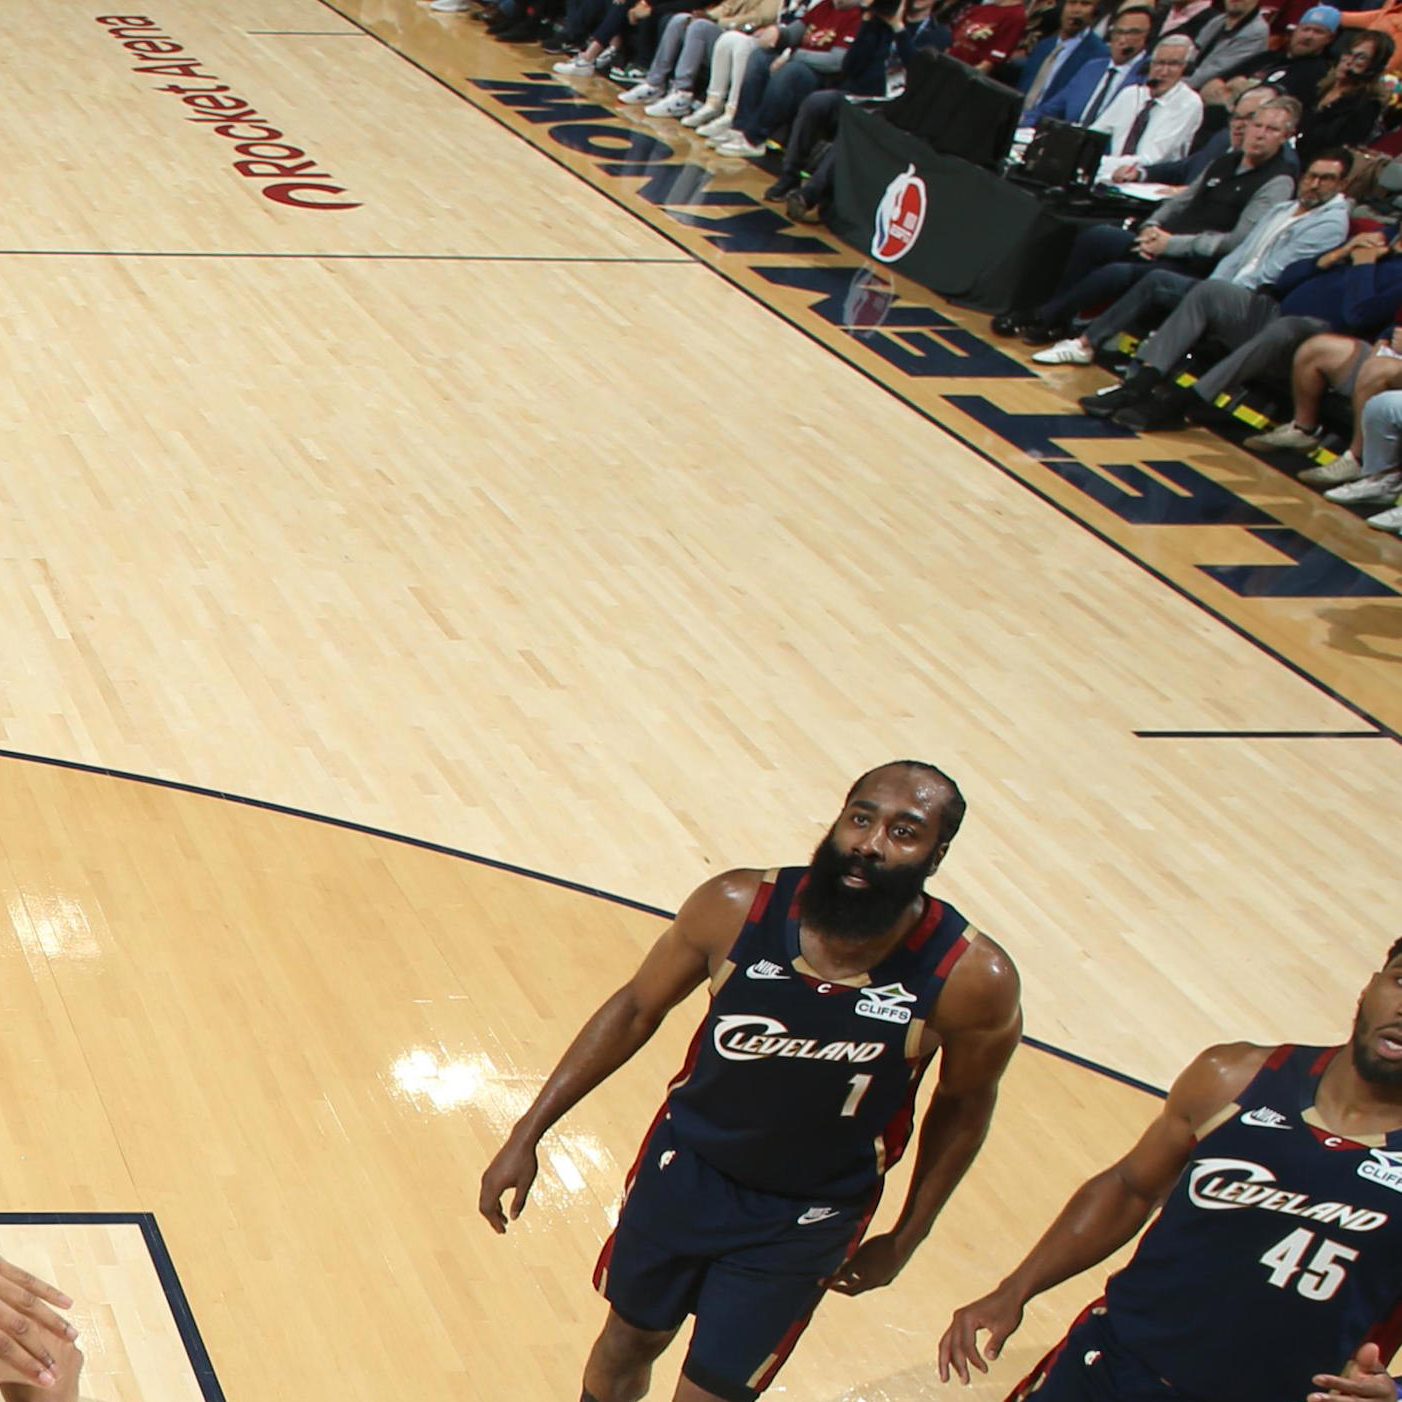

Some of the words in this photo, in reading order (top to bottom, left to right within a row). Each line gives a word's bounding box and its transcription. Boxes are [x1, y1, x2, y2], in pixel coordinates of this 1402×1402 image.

[95, 15, 220, 80] Arena
[152, 84, 333, 179] Rocket
[754, 959, 784, 976] NIKE
[713, 1013, 886, 1062] CLEVELAND
[857, 1002, 909, 1021] CLIFFS
[839, 1073, 874, 1117] 1
[1187, 1157, 1389, 1232] CLEVELAND
[1258, 1226, 1361, 1302] 45
